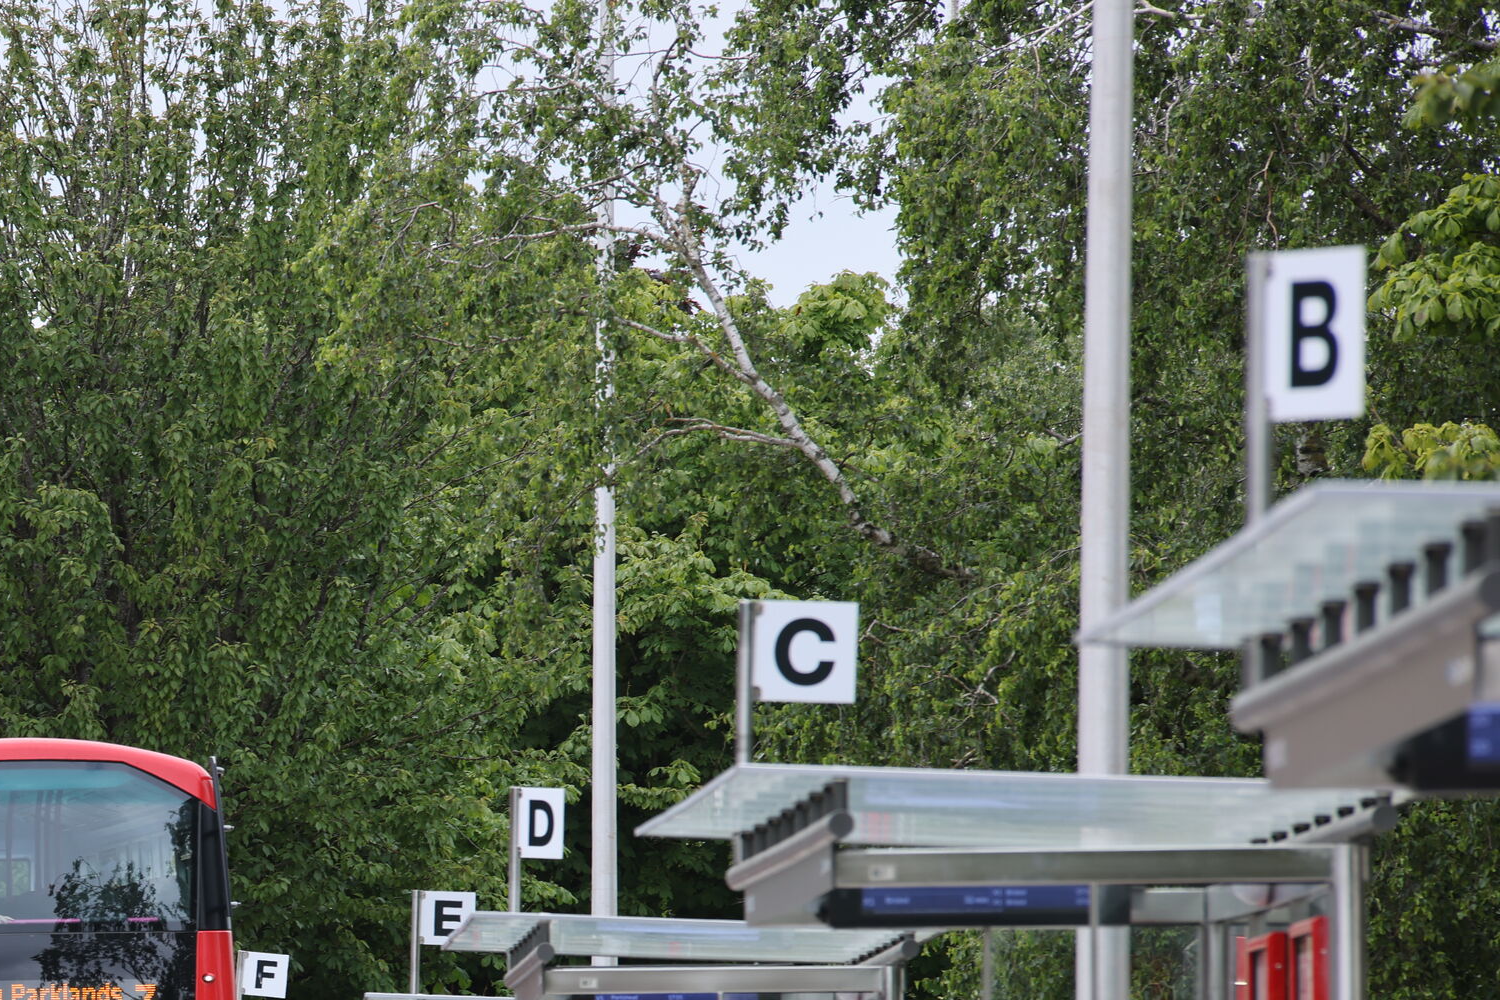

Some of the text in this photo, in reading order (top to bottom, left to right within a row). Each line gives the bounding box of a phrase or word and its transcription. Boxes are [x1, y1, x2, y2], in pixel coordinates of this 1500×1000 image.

[1290, 280, 1339, 388] B
[774, 617, 836, 686] C
[527, 800, 553, 847] D
[434, 900, 463, 937] E
[255, 960, 278, 989] F
